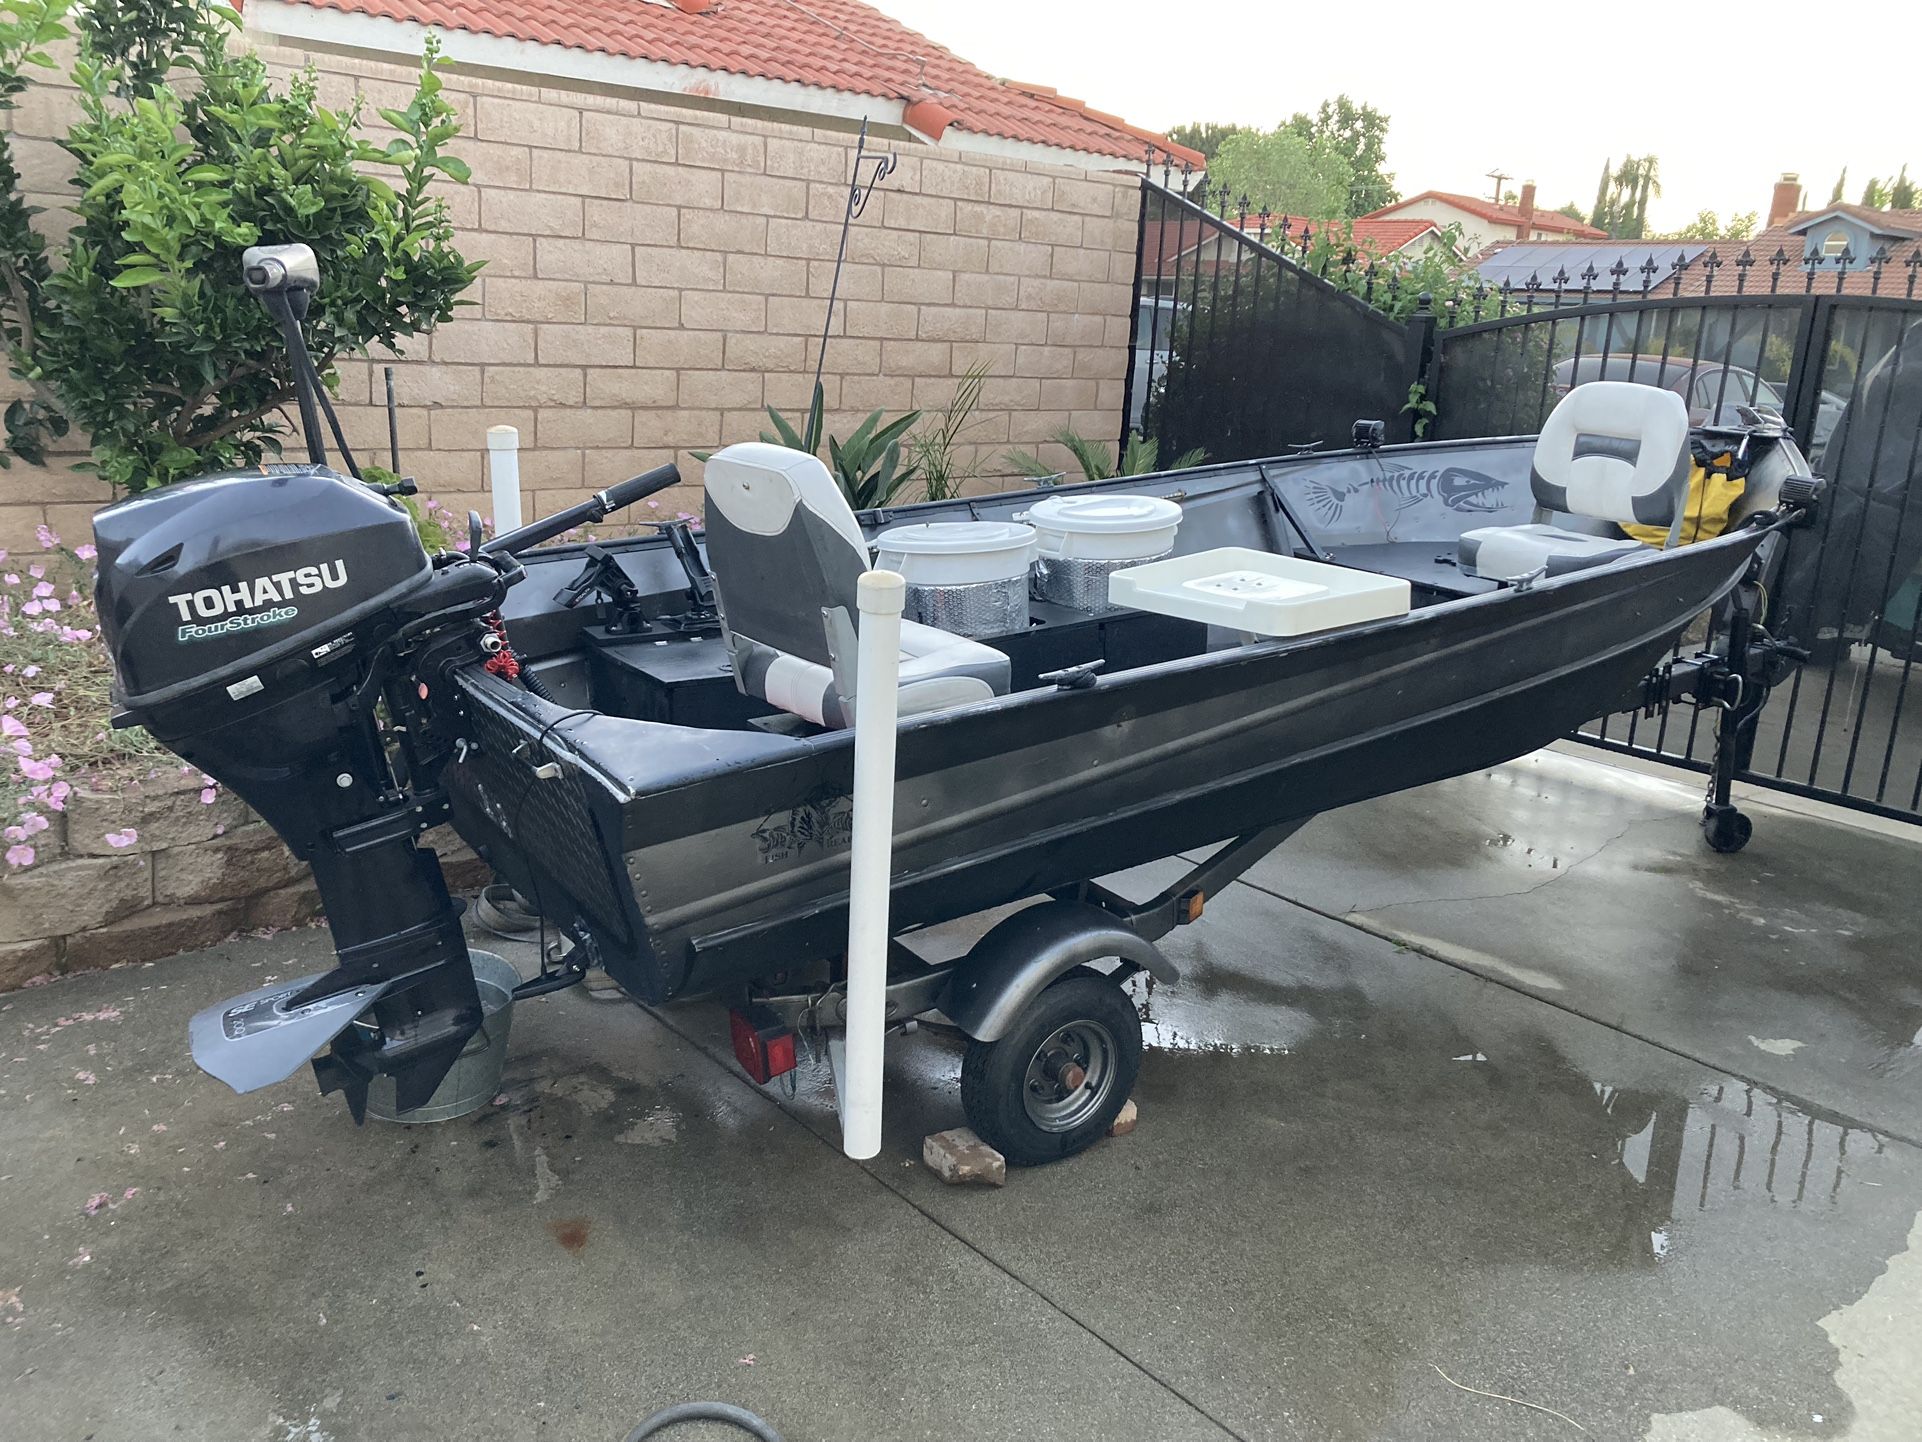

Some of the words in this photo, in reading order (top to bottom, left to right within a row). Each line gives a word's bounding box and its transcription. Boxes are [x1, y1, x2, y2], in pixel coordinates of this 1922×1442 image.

[168, 559, 348, 622] TOHATSU
[178, 606, 298, 641] FourStroke
[228, 1001, 258, 1017] SE
